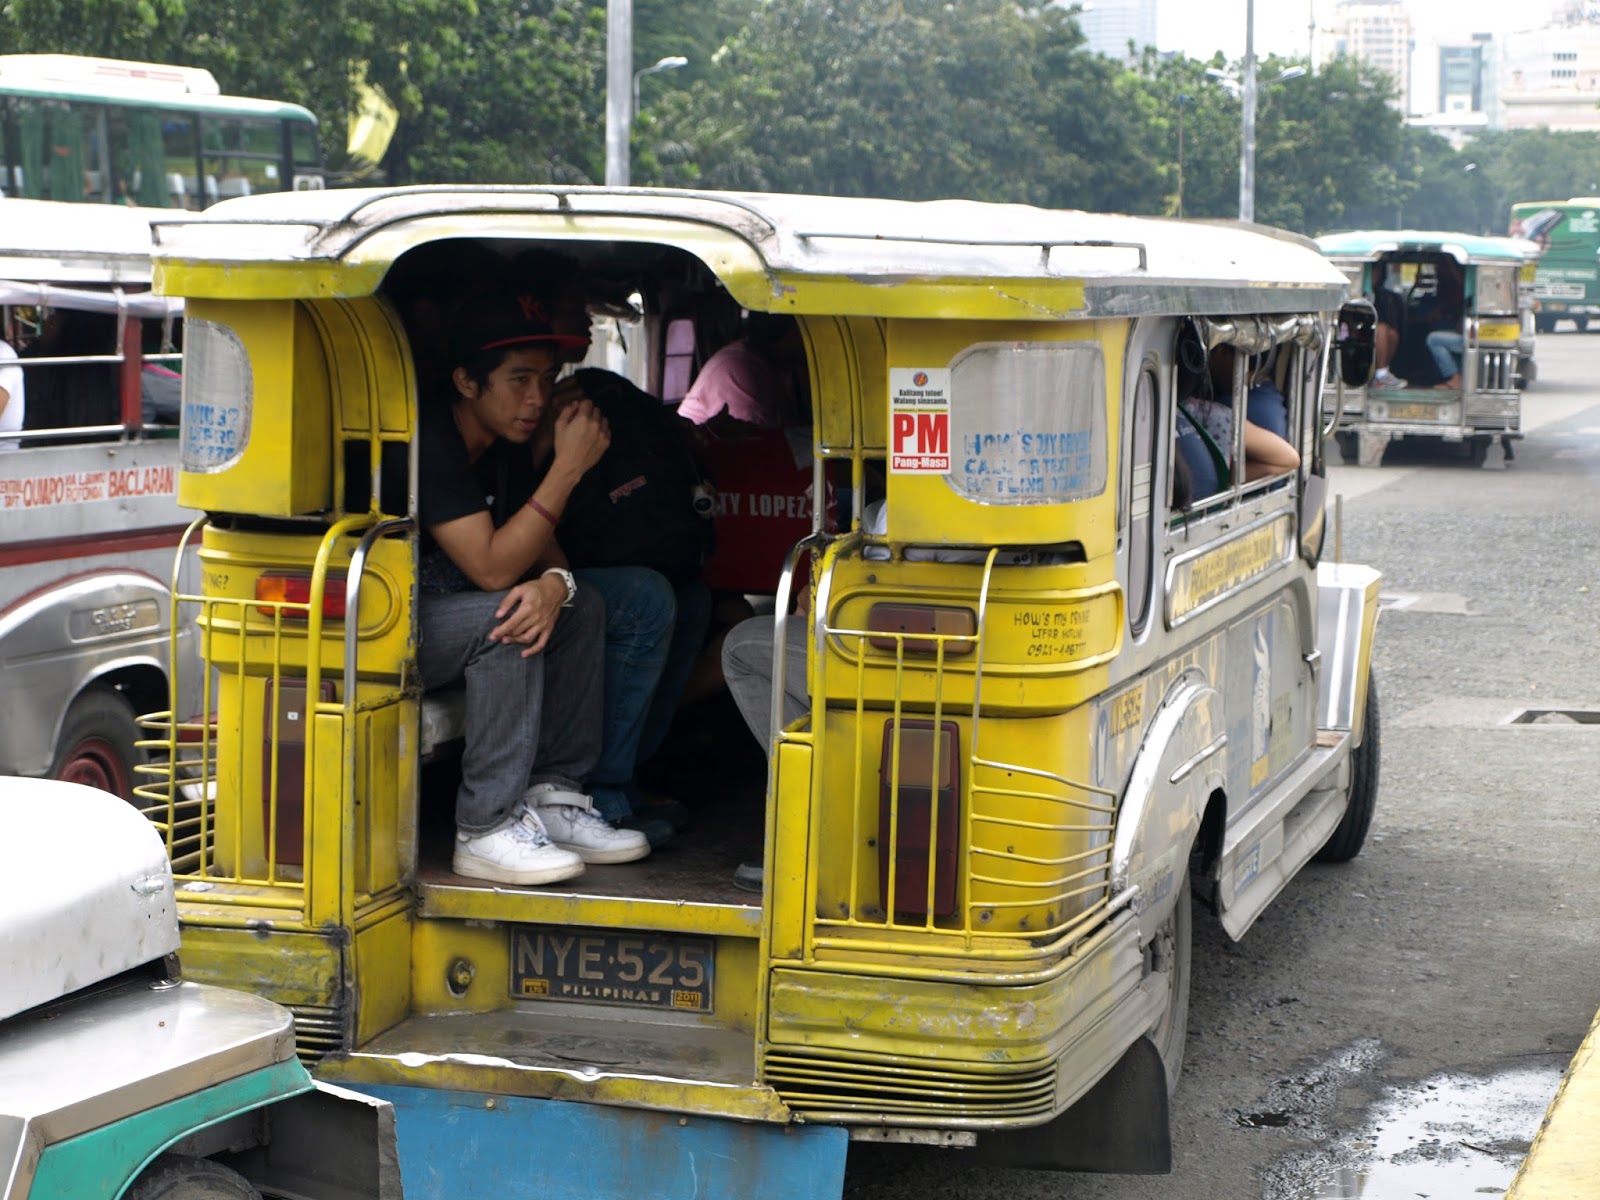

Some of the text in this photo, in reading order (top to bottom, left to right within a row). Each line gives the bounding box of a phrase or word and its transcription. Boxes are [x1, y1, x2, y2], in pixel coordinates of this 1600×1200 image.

[893, 397, 916, 405] Walang
[893, 413, 948, 454] PM
[894, 456, 947, 469] Pang-Masa
[108, 466, 175, 498] BACLARAN
[749, 493, 807, 519] LOPEZ
[562, 983, 661, 1001] PILIPINAS
[676, 992, 699, 1002] 2011
